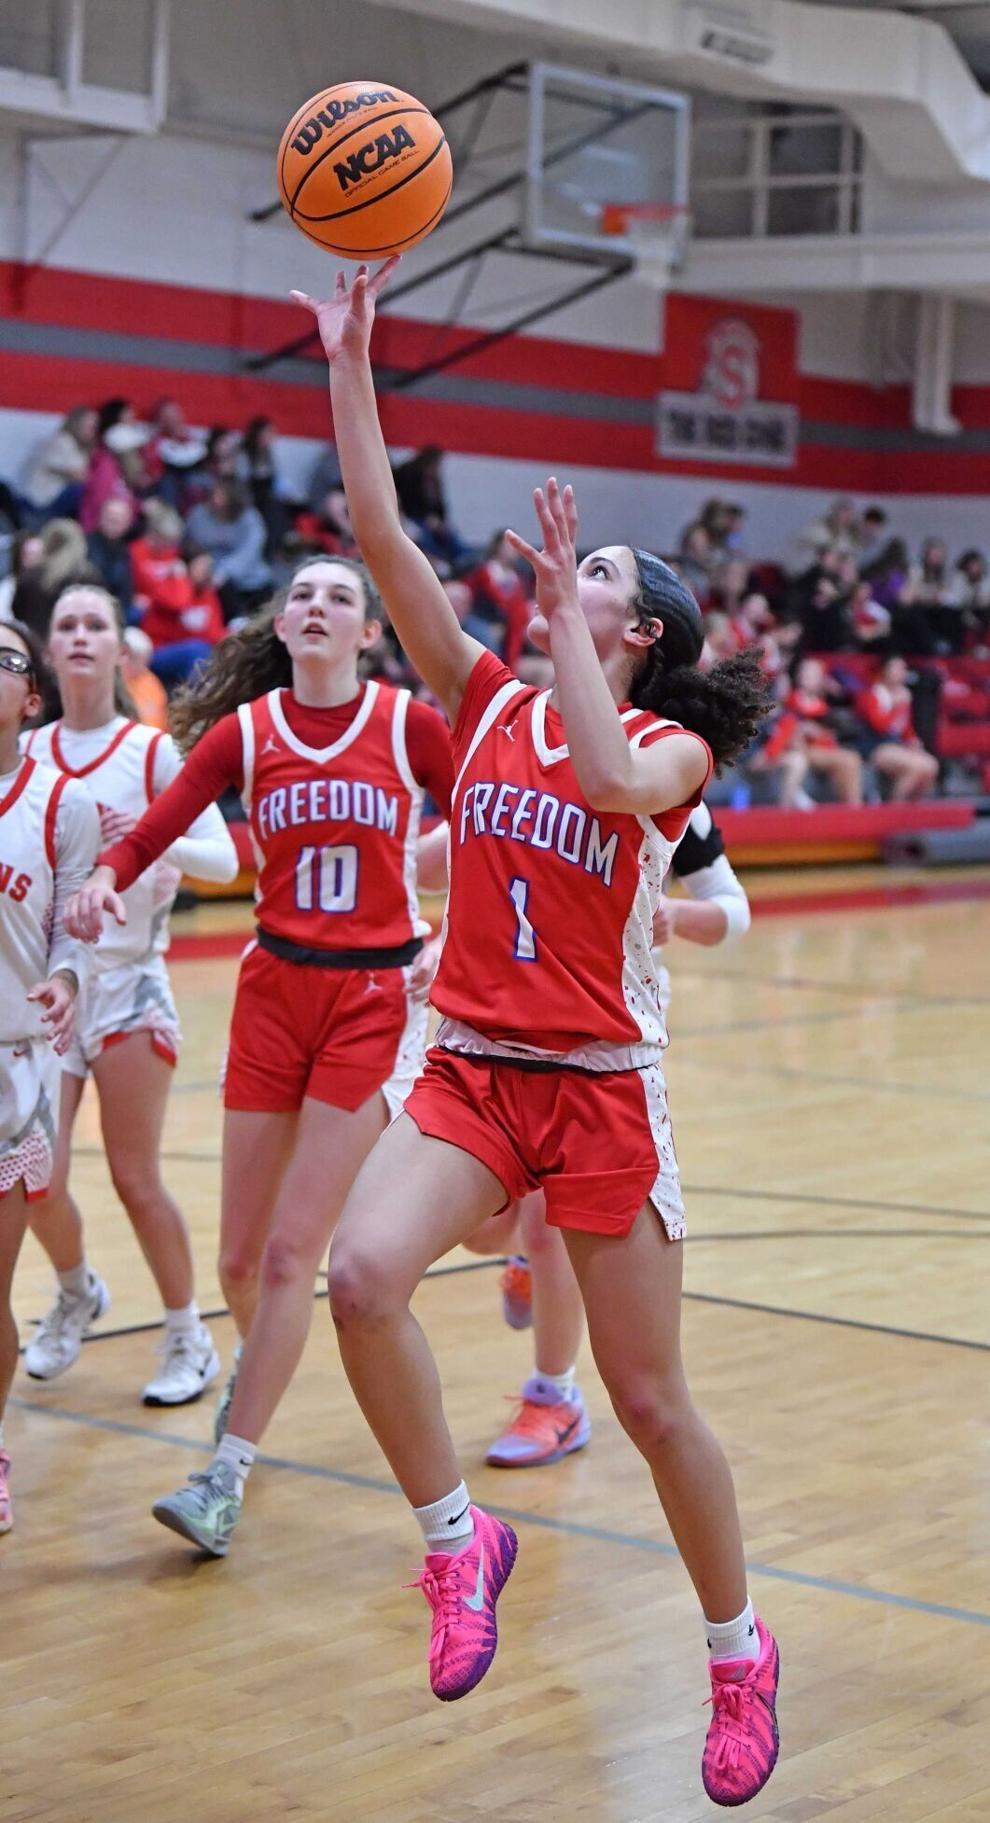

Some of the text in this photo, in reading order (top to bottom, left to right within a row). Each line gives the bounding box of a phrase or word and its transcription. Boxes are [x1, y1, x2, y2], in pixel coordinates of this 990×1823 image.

[333, 124, 416, 191] NCAA
[378, 159, 400, 176] GAME
[401, 150, 420, 161] BALL
[258, 779, 398, 840] FREEDOM
[458, 781, 620, 889] FREEDOM
[295, 843, 358, 913] 10
[508, 876, 539, 963] 1
